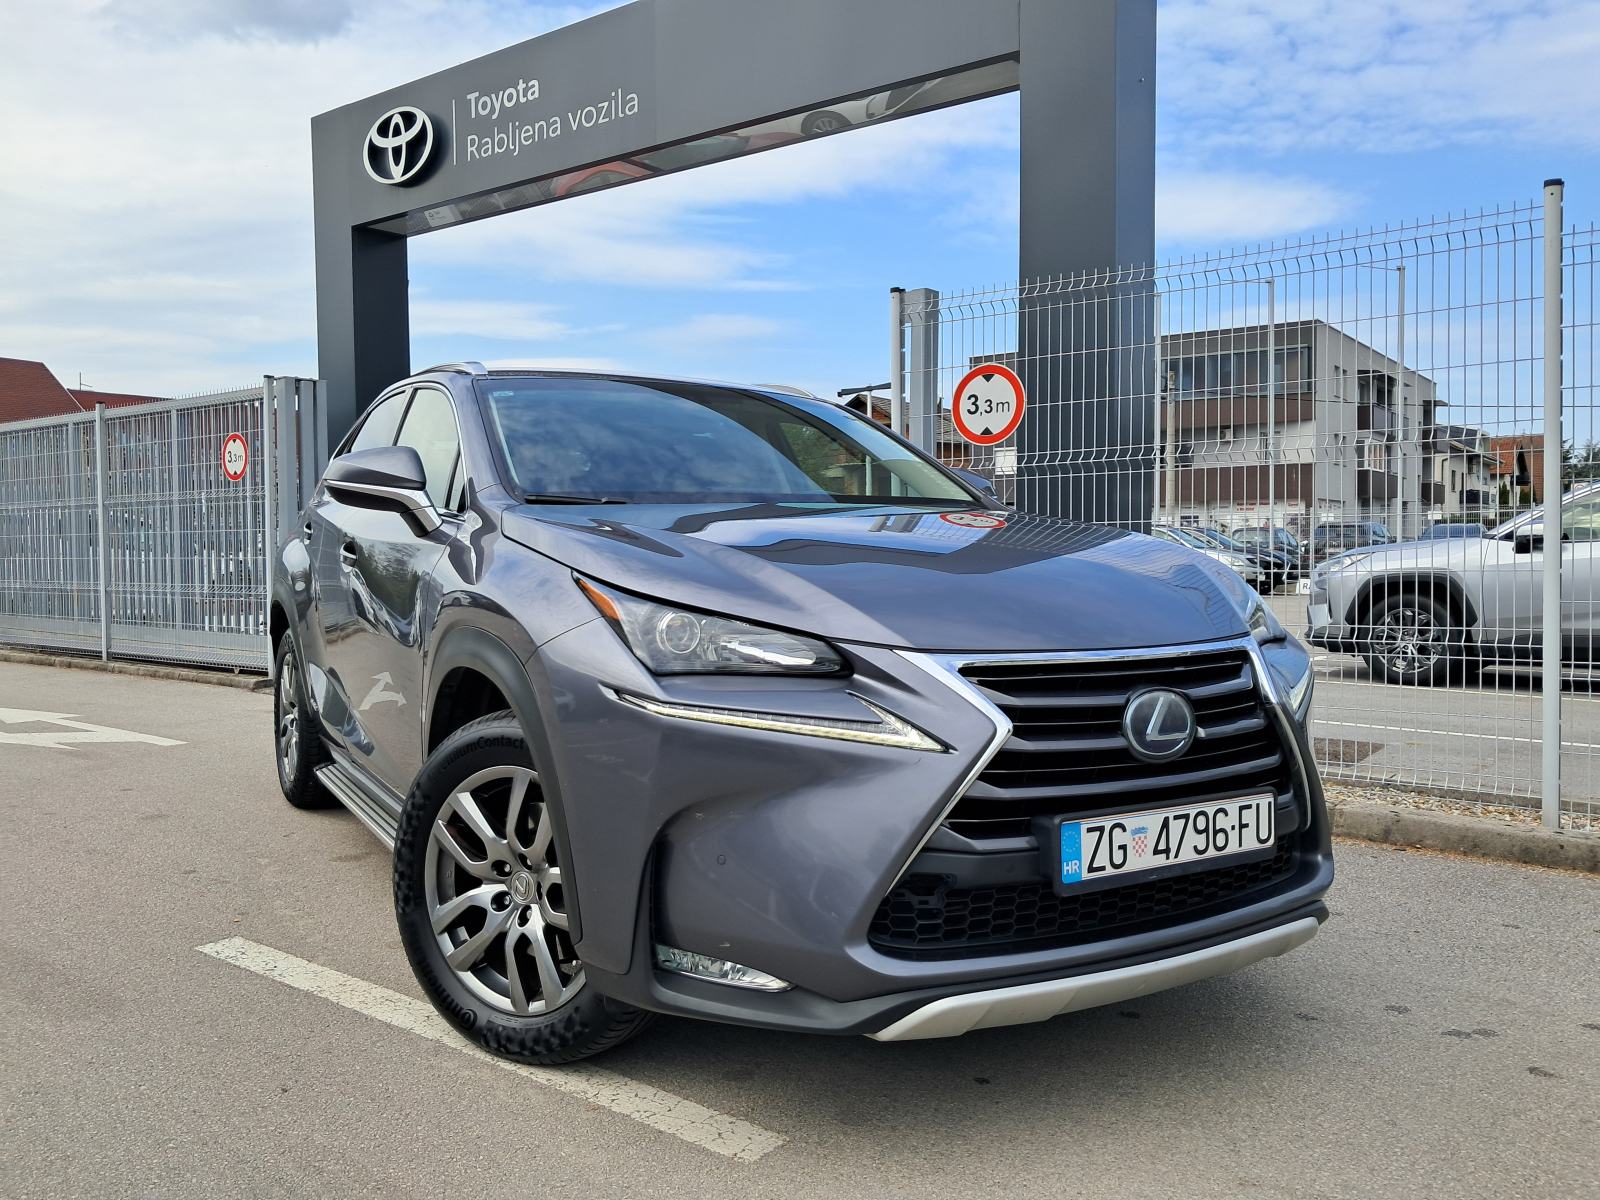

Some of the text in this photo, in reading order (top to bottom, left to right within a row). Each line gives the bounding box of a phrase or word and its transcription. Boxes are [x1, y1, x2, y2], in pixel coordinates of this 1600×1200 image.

[467, 78, 540, 120] Toyota
[467, 87, 640, 163] Rabljena vozila
[1063, 859, 1080, 876] HR
[1086, 822, 1128, 874] ZG
